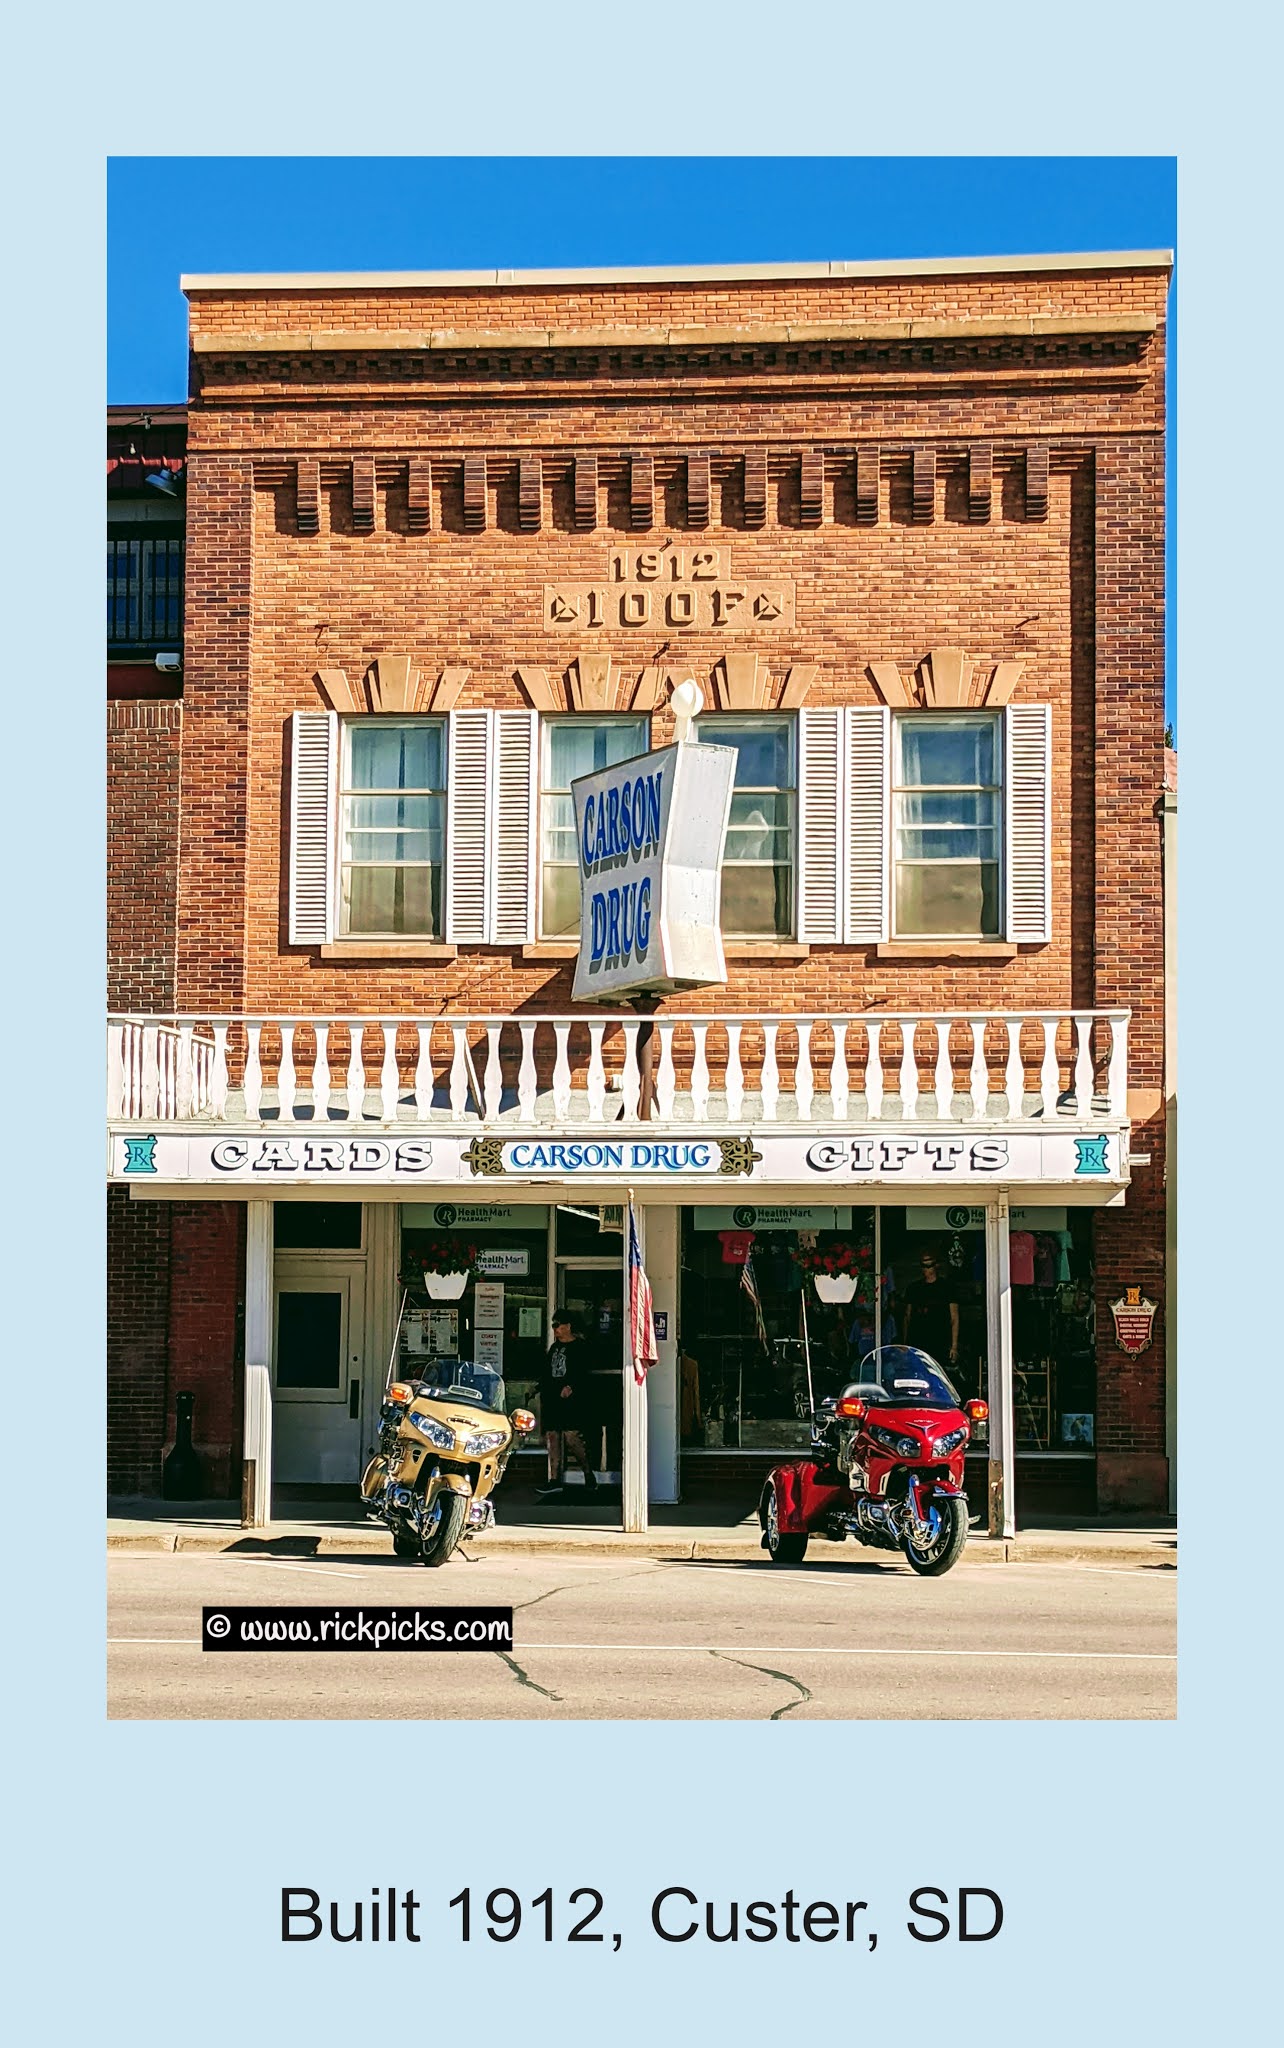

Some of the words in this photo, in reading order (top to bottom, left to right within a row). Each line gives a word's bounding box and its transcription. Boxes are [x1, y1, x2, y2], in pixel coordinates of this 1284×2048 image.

[612, 550, 720, 582] 1912
[587, 587, 747, 628] IOOF
[582, 771, 663, 874] CARSON
[590, 876, 651, 970] DRUG
[211, 1139, 434, 1171] CARDS
[511, 1144, 624, 1170] CARSON
[630, 1144, 711, 1169] DRUG
[805, 1139, 1010, 1172] GIFTS
[458, 1207, 488, 1217] Health
[757, 1208, 788, 1218] Health
